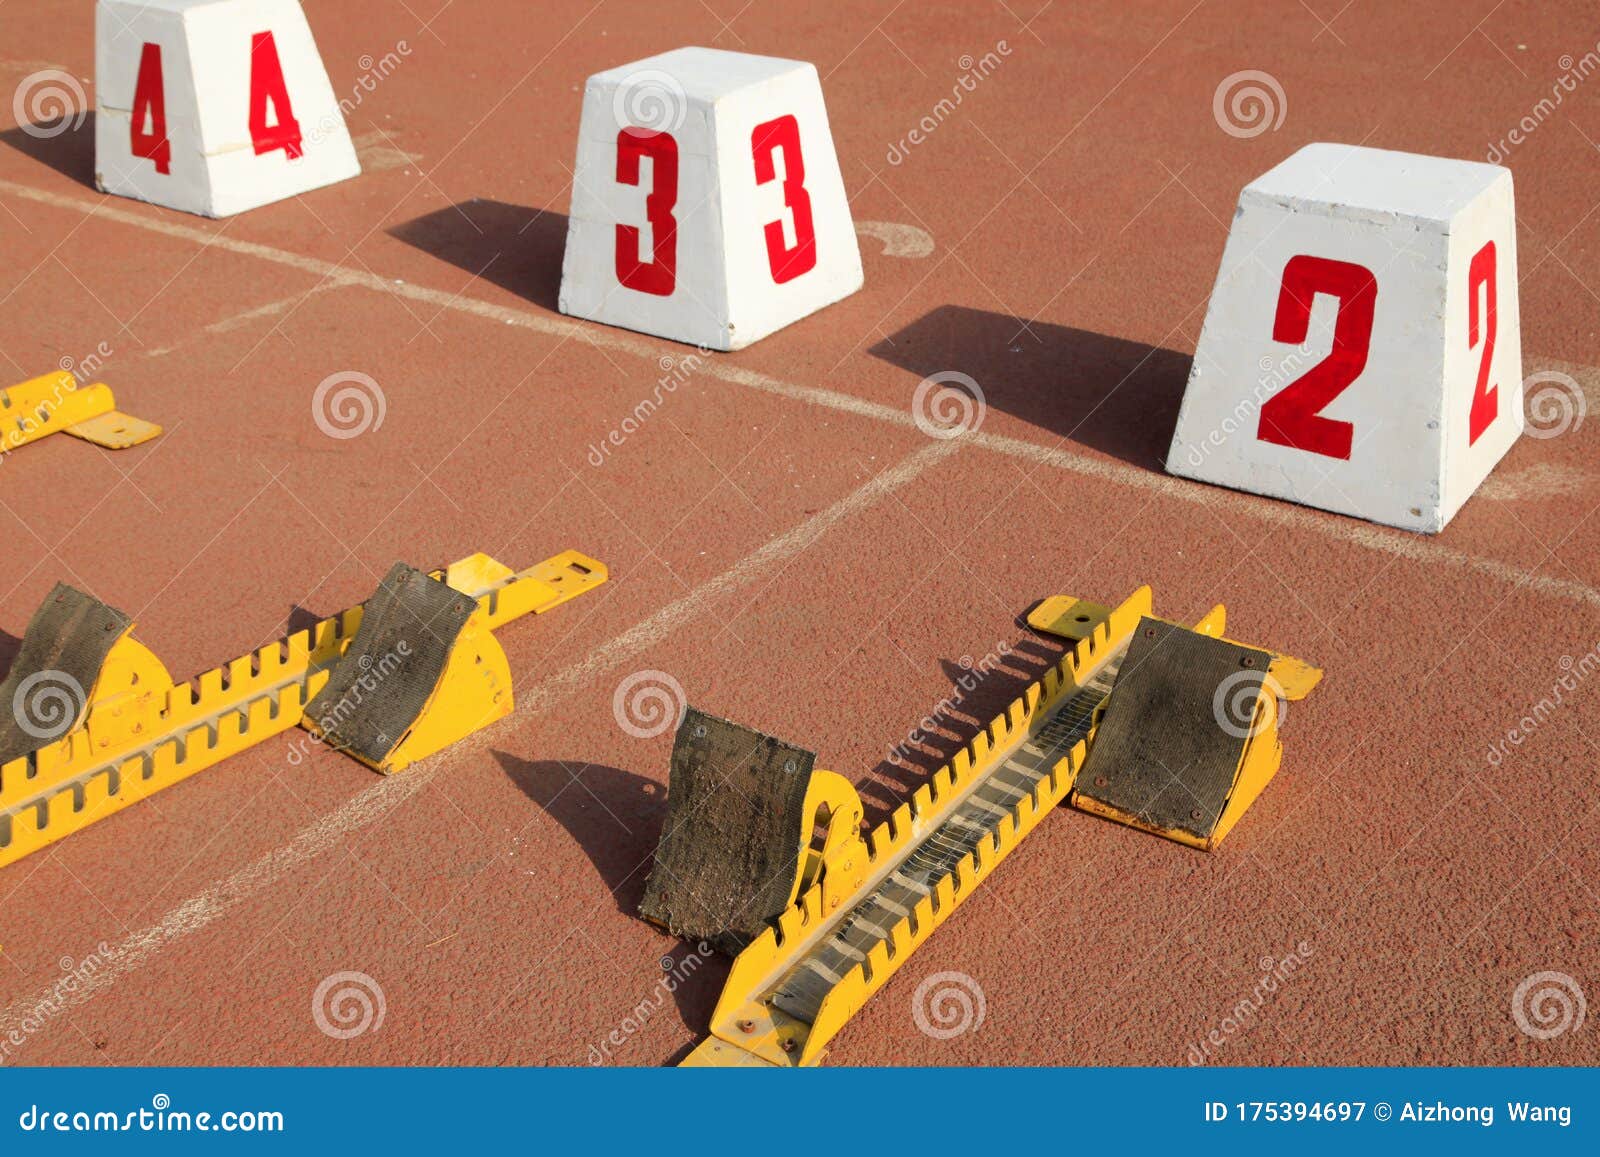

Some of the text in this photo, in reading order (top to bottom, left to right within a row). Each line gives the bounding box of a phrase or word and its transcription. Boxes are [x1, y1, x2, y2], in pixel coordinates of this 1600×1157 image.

[130, 42, 170, 176] 4
[248, 30, 304, 161] 4
[615, 126, 679, 297] 3
[751, 114, 817, 285] 3
[1257, 255, 1378, 461] 2
[1469, 240, 1498, 448] 2
